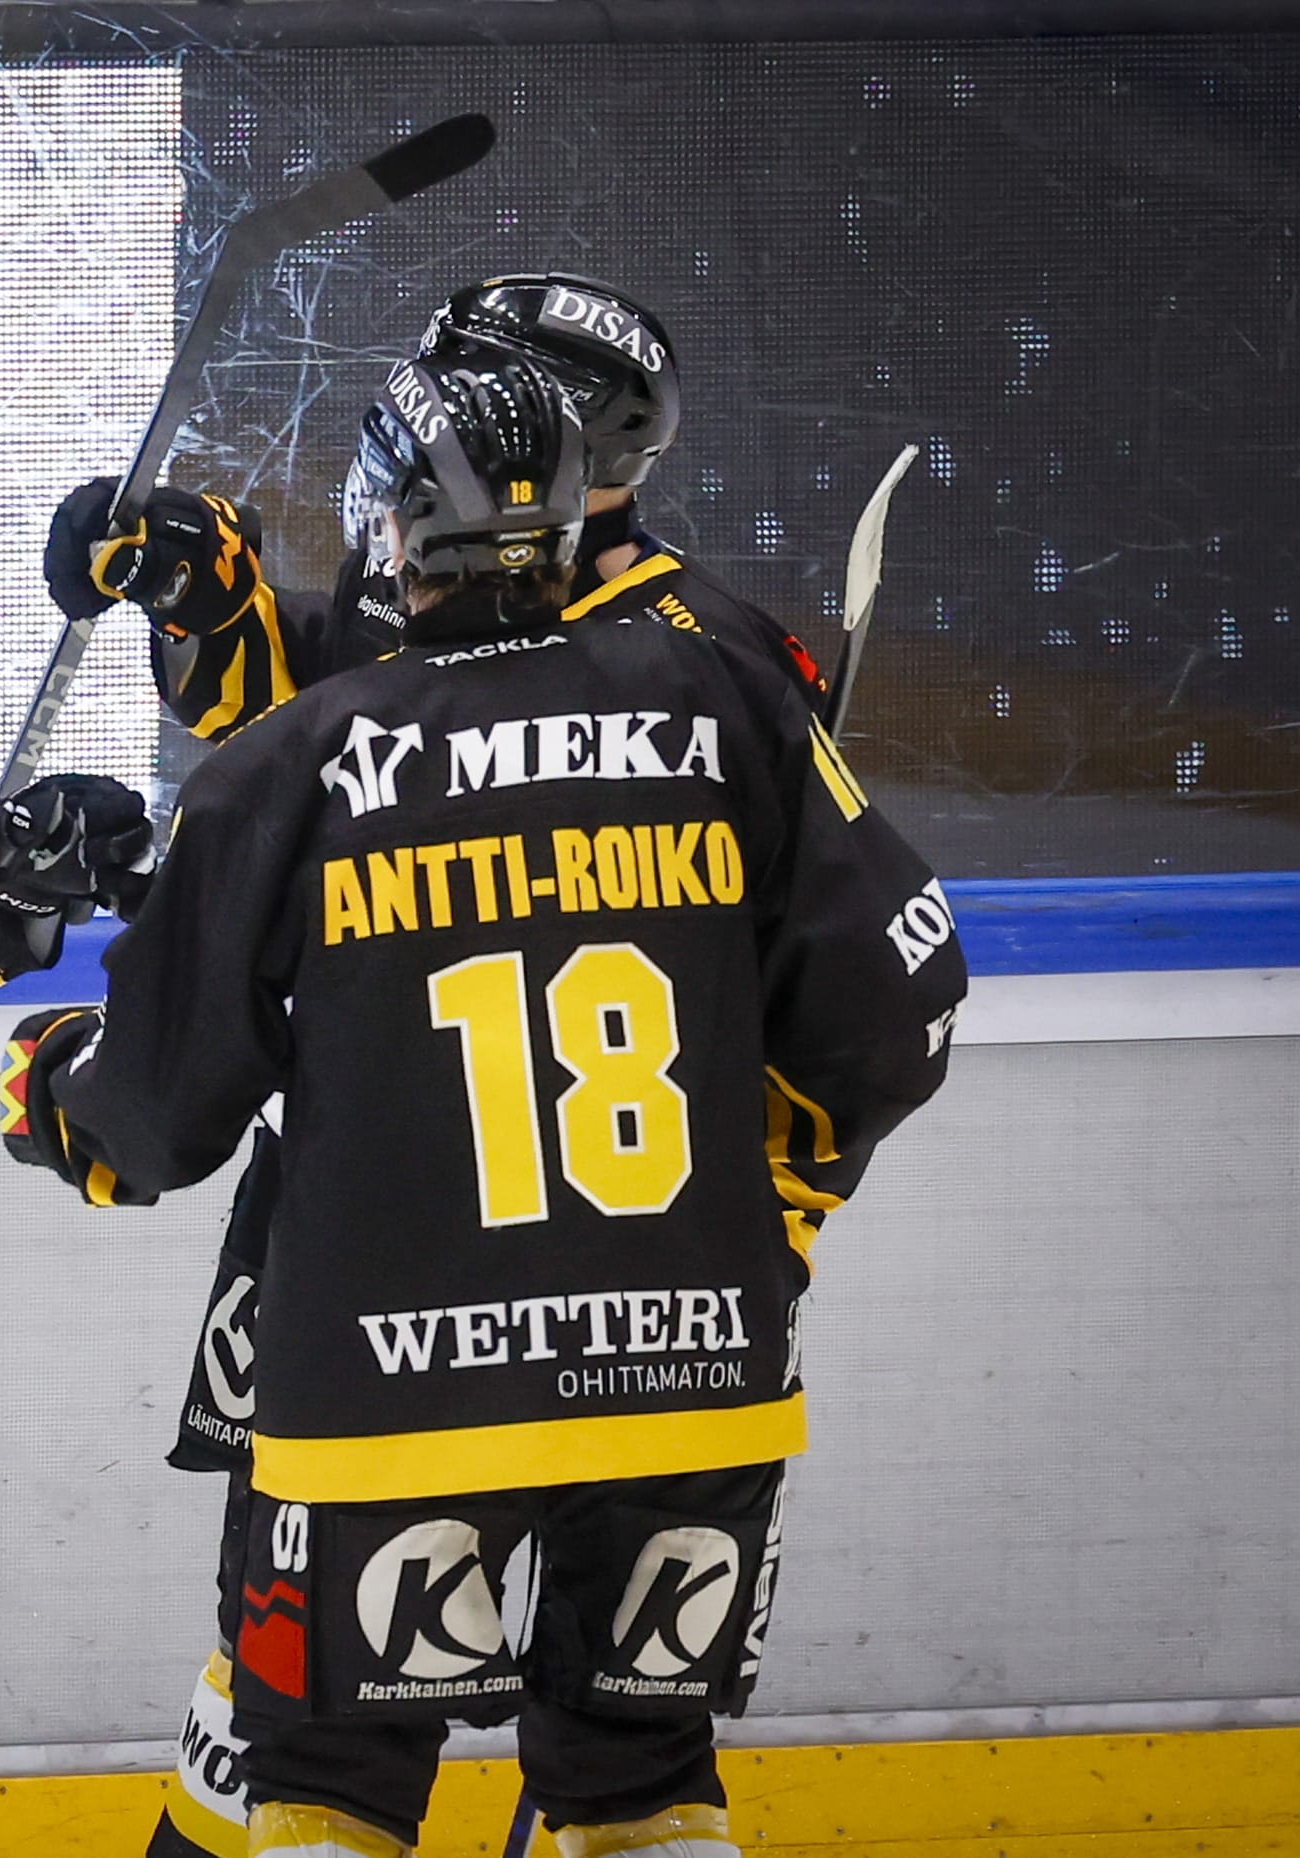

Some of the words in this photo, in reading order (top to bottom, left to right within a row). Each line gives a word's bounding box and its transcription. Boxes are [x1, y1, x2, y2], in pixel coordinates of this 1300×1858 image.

[547, 289, 667, 373] DISAS
[388, 365, 448, 445] DISAS
[509, 480, 533, 505] 18
[424, 633, 569, 668] TACKLA
[16, 663, 75, 768] CCM
[444, 710, 727, 798] MEKA
[322, 820, 745, 947] ANTTI-ROIKO
[426, 941, 693, 1229] 18
[358, 1286, 751, 1376] WETTERI
[556, 1359, 747, 1399] OHITTAMATON.
[356, 1675, 524, 1701] Karkkainen.com
